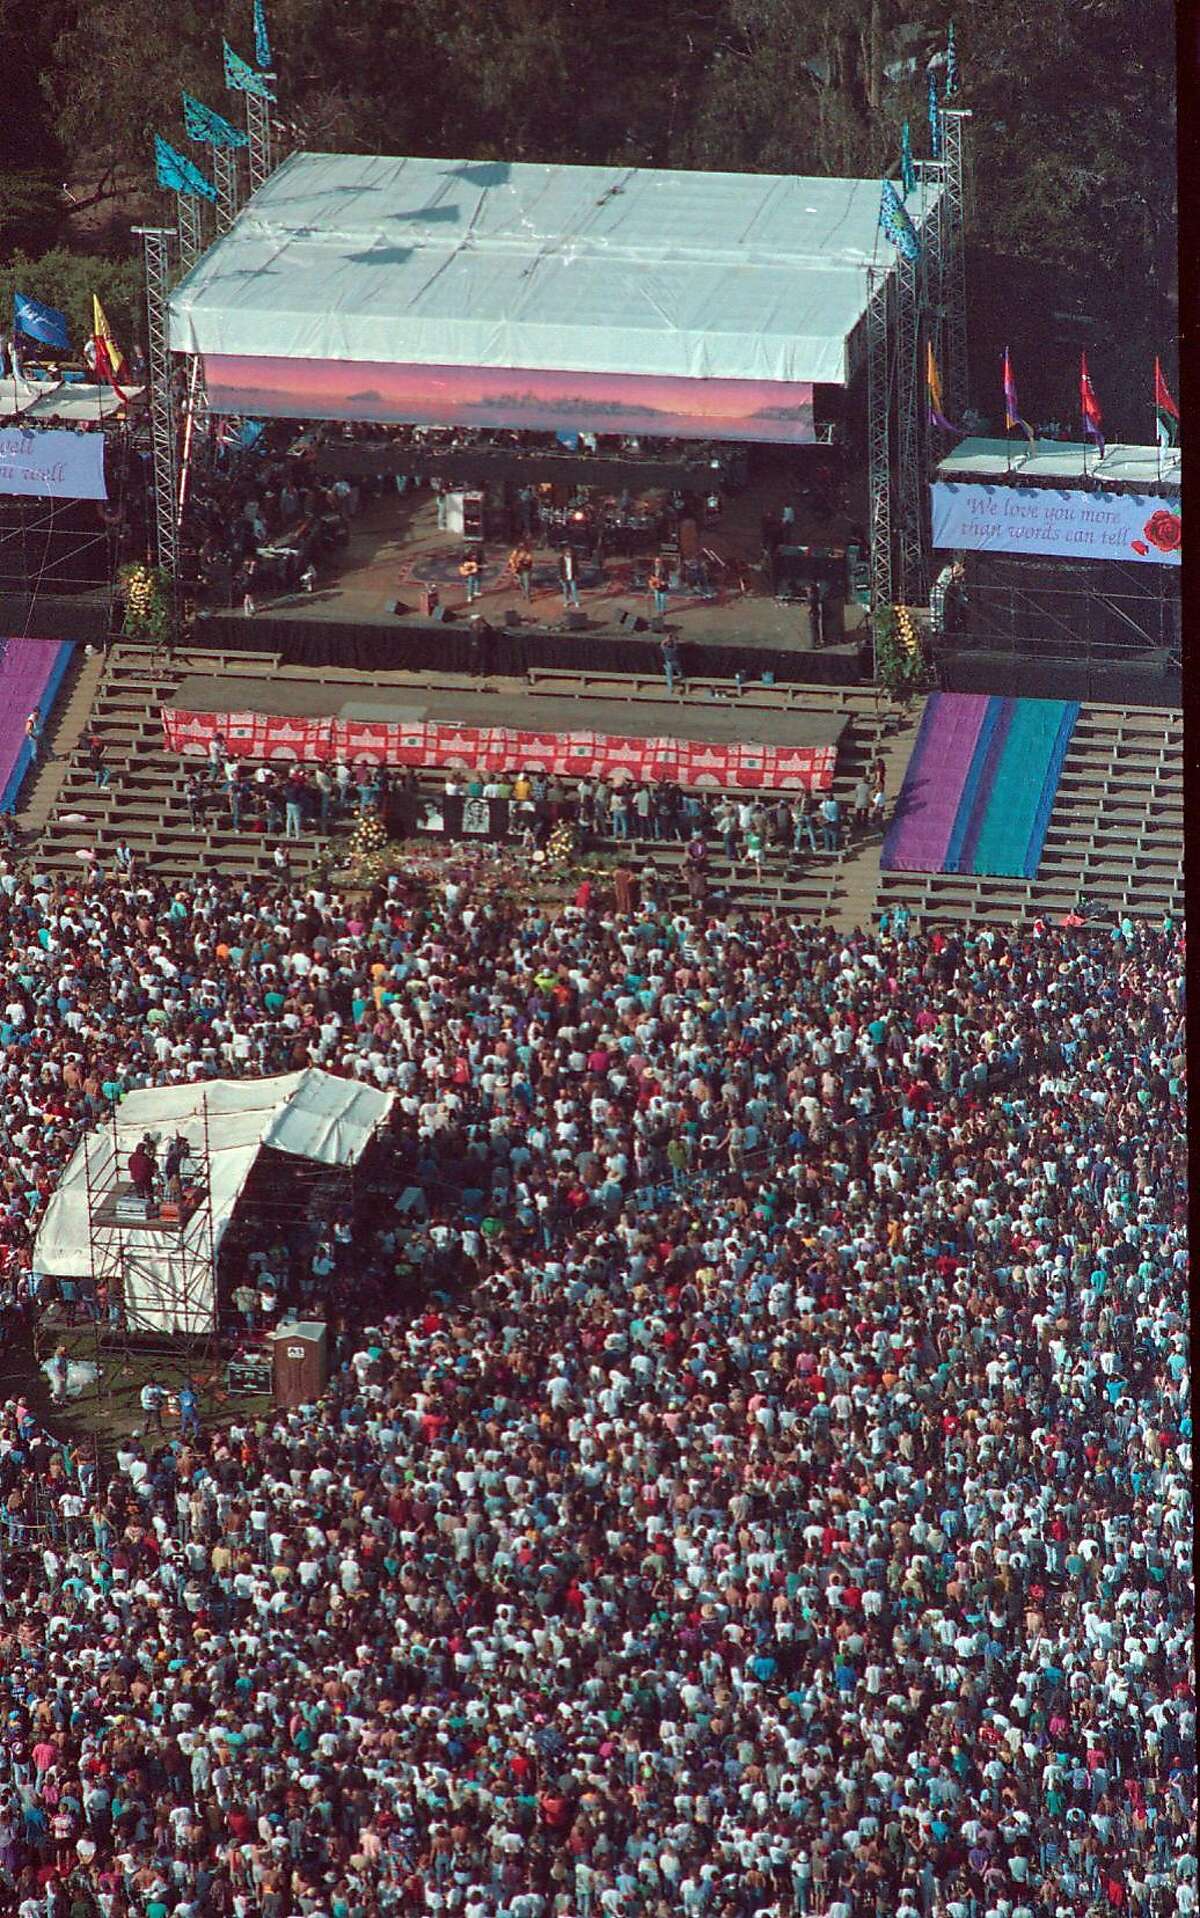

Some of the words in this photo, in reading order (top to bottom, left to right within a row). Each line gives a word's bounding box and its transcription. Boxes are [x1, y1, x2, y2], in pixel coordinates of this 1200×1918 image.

[22, 462, 67, 482] well
[966, 497, 997, 516] We
[1003, 498, 1038, 519] love
[1043, 506, 1077, 522] you
[1080, 509, 1121, 525] more
[961, 519, 1003, 537] than
[1008, 522, 1061, 540] words
[1065, 528, 1095, 545] can
[1101, 527, 1131, 547] tell
